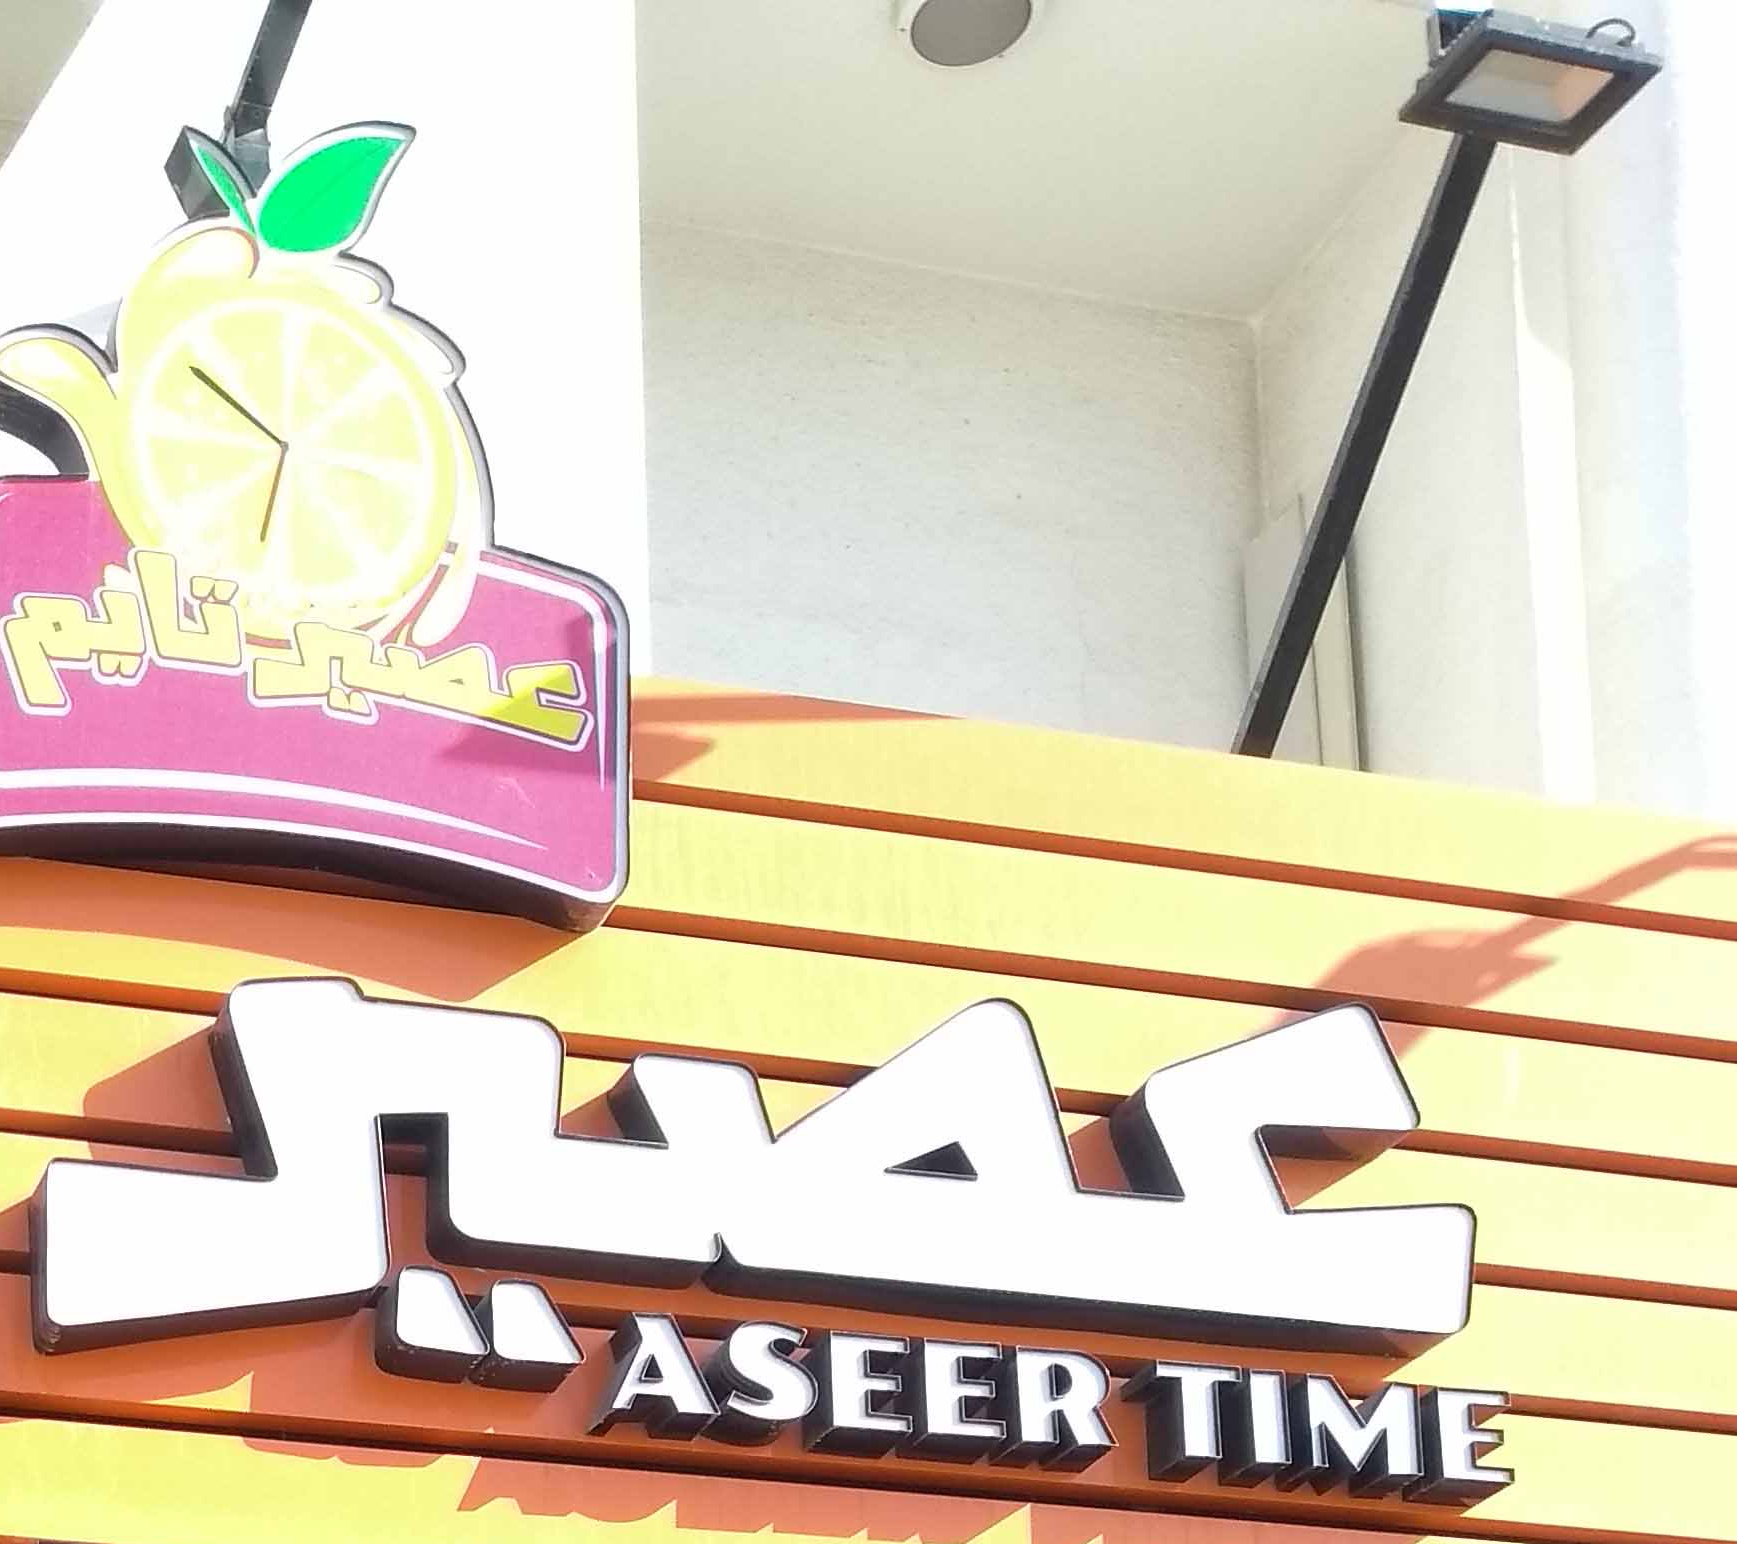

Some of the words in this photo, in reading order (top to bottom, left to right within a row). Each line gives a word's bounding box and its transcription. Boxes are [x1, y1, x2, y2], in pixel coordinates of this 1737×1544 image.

[0, 542, 243, 714] تايم
[248, 618, 595, 750] عصير
[31, 976, 1476, 1390] عصير
[601, 1312, 1115, 1460] ASEER
[1138, 1358, 1513, 1500] TIME
